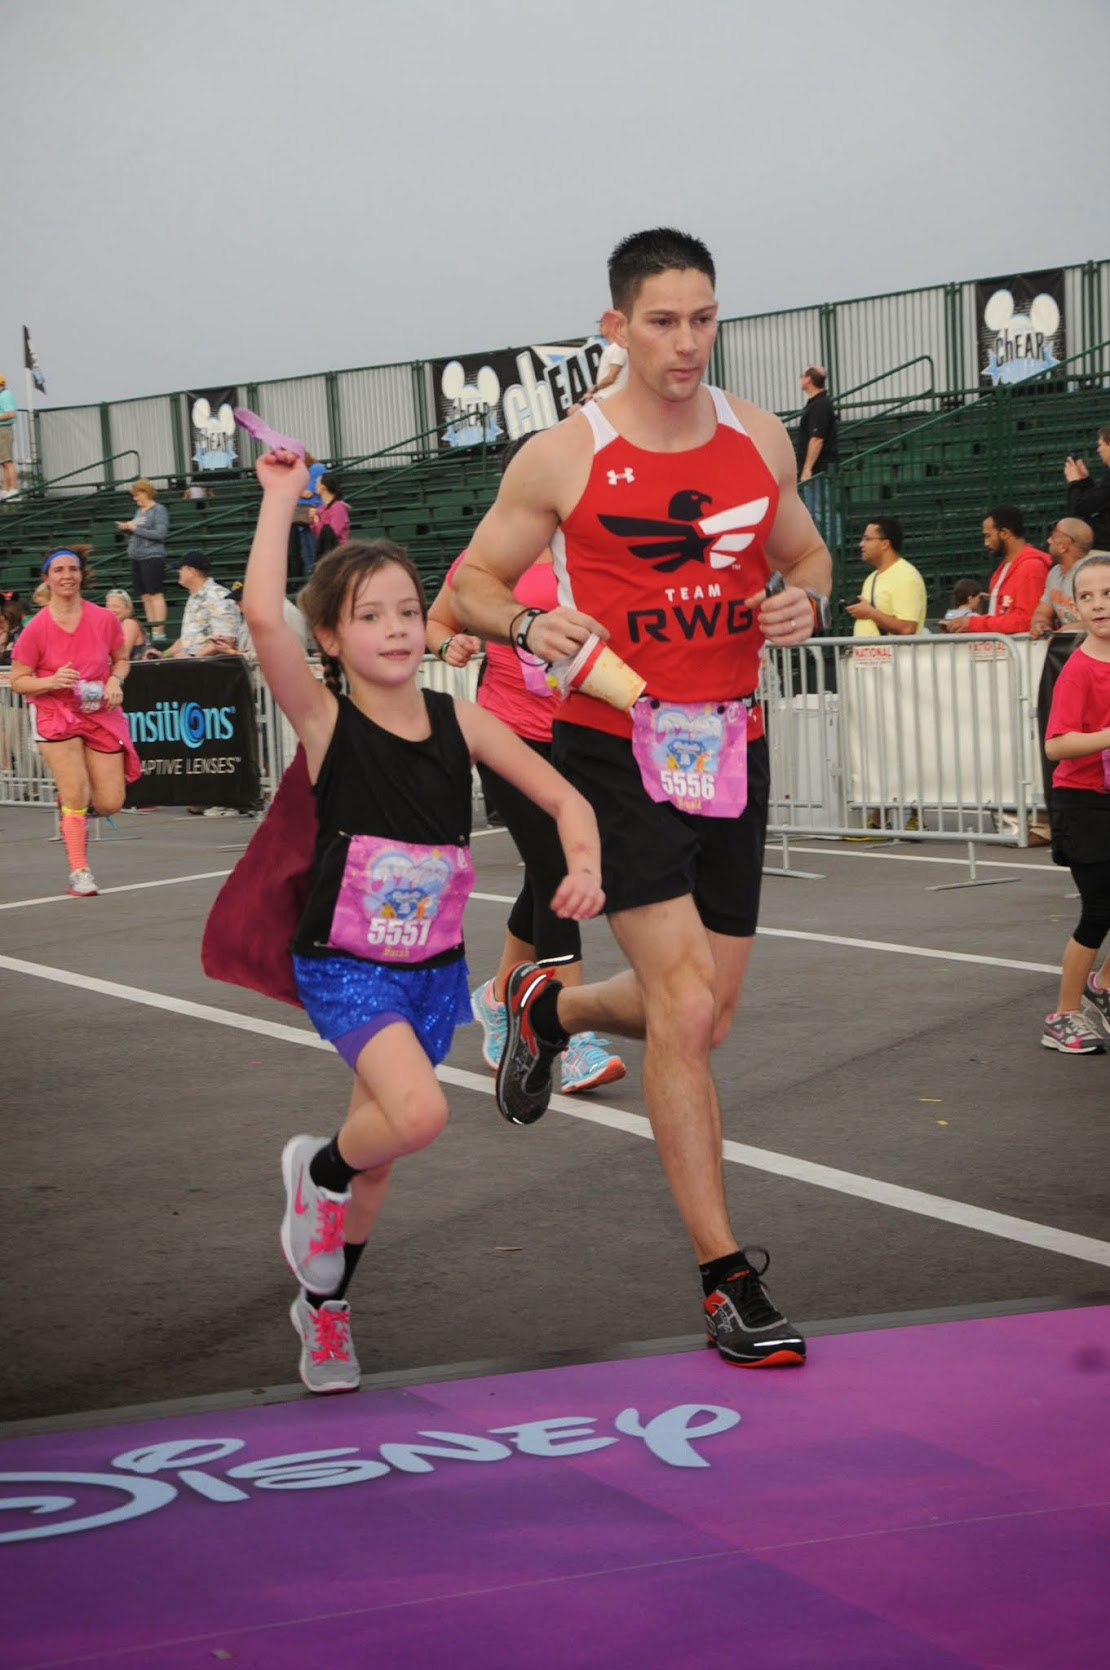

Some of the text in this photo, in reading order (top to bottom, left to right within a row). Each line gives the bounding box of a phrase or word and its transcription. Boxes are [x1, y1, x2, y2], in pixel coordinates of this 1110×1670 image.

[664, 583, 721, 602] TEAM
[140, 758, 183, 775] APTIVE
[660, 769, 715, 800] 5556
